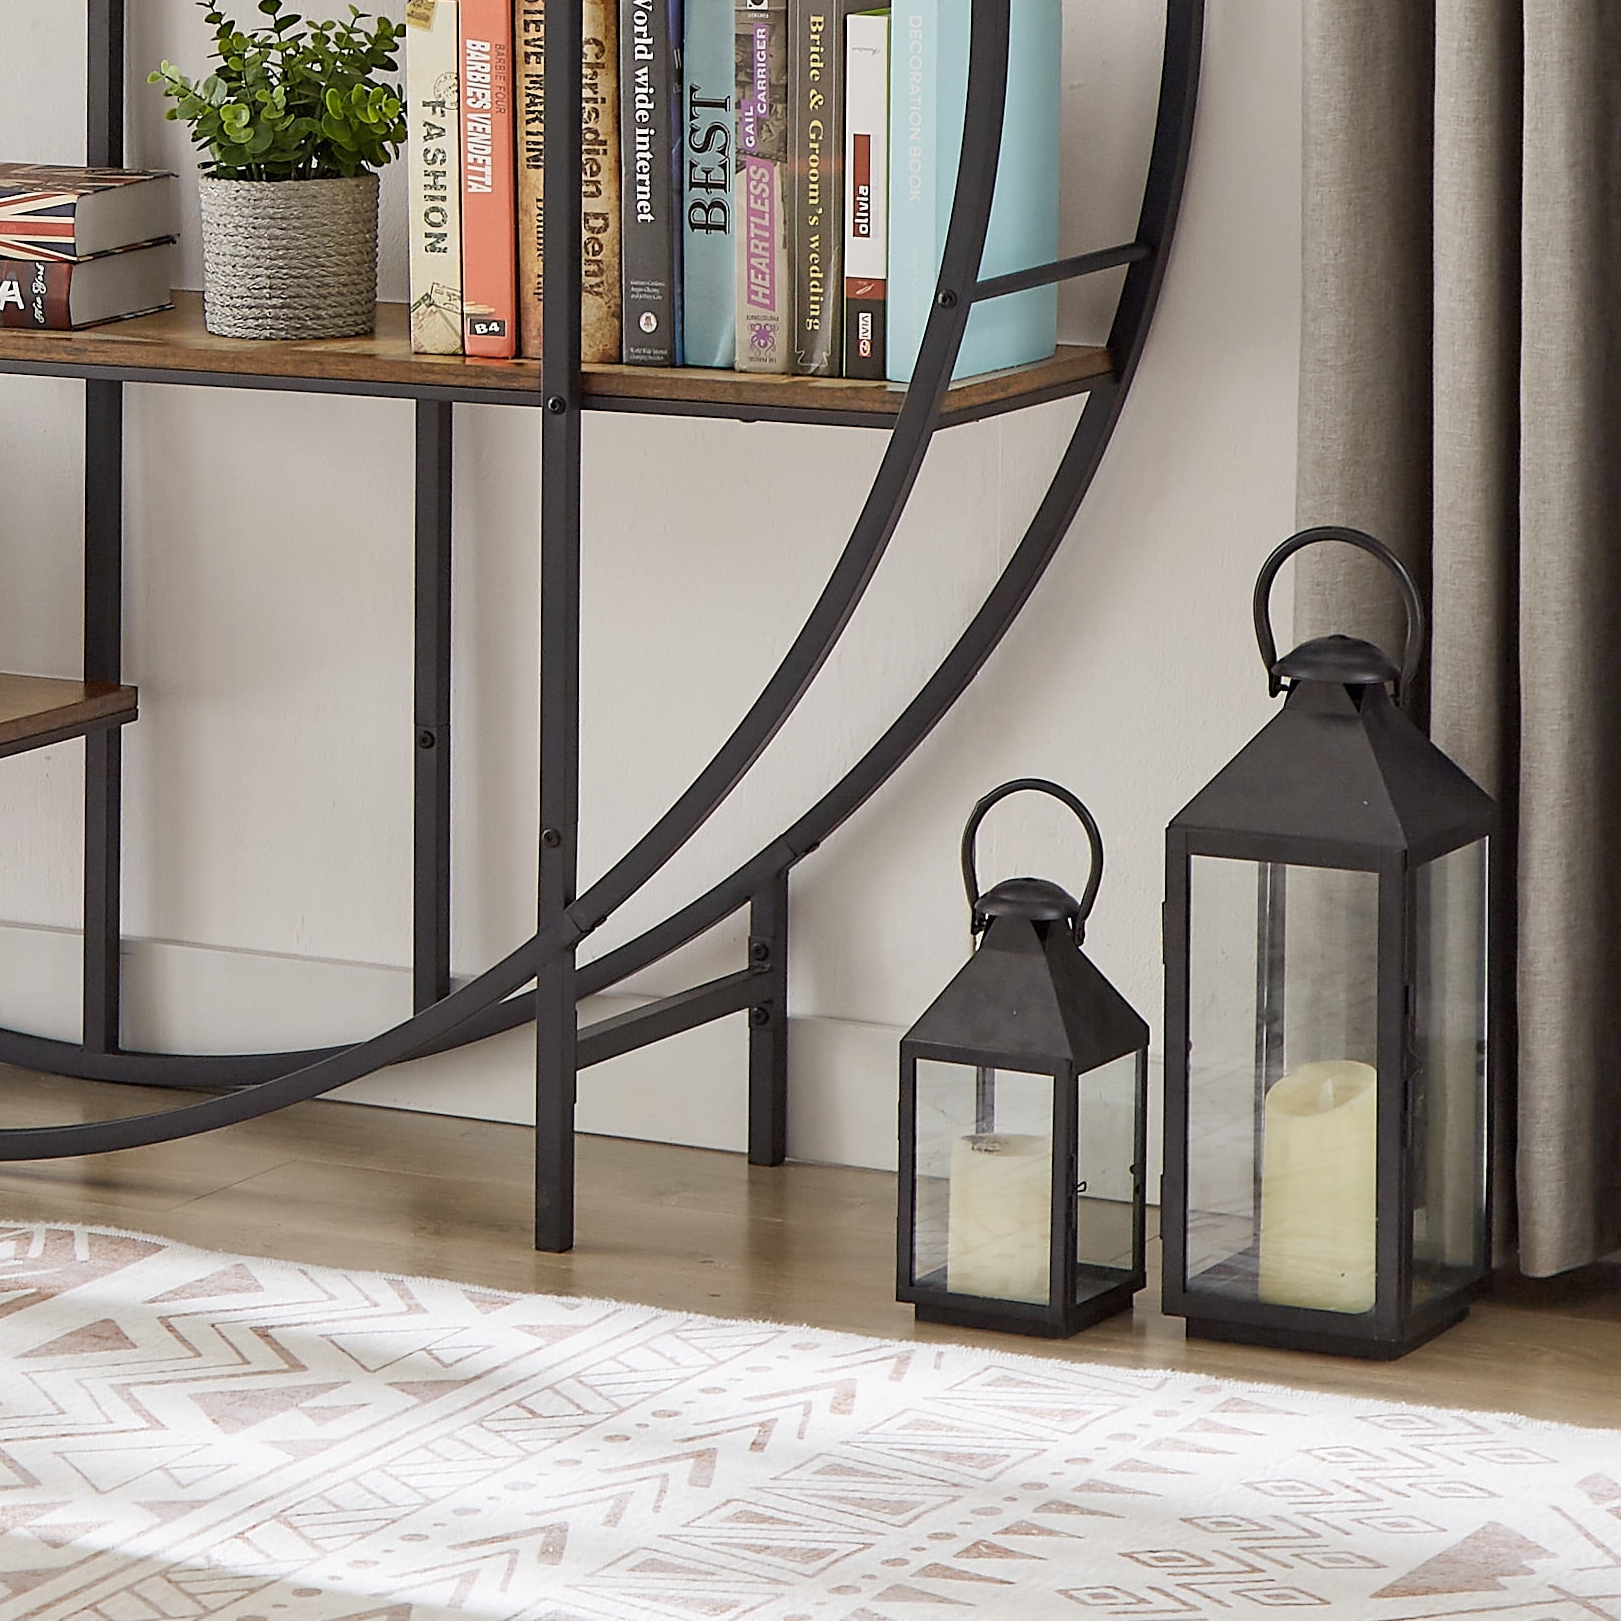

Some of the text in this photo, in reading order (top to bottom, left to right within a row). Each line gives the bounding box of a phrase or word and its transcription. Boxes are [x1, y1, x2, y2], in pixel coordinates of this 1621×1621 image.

[465, 38, 493, 194] BARBIES VENDETTA
[494, 43, 506, 115] BARBIE FOUR
[634, 65, 656, 124] wide
[745, 106, 755, 148] GAIL
[757, 28, 767, 114] CARRIGER
[908, 15, 924, 203] DECORATION BOOK
[422, 100, 448, 254] FASHION
[635, 127, 656, 223] internet
[688, 82, 731, 235] BEST
[806, 15, 824, 331] Bride & Groom's wedding
[855, 185, 869, 235] olivia
[750, 164, 770, 305] HEARTLESS
